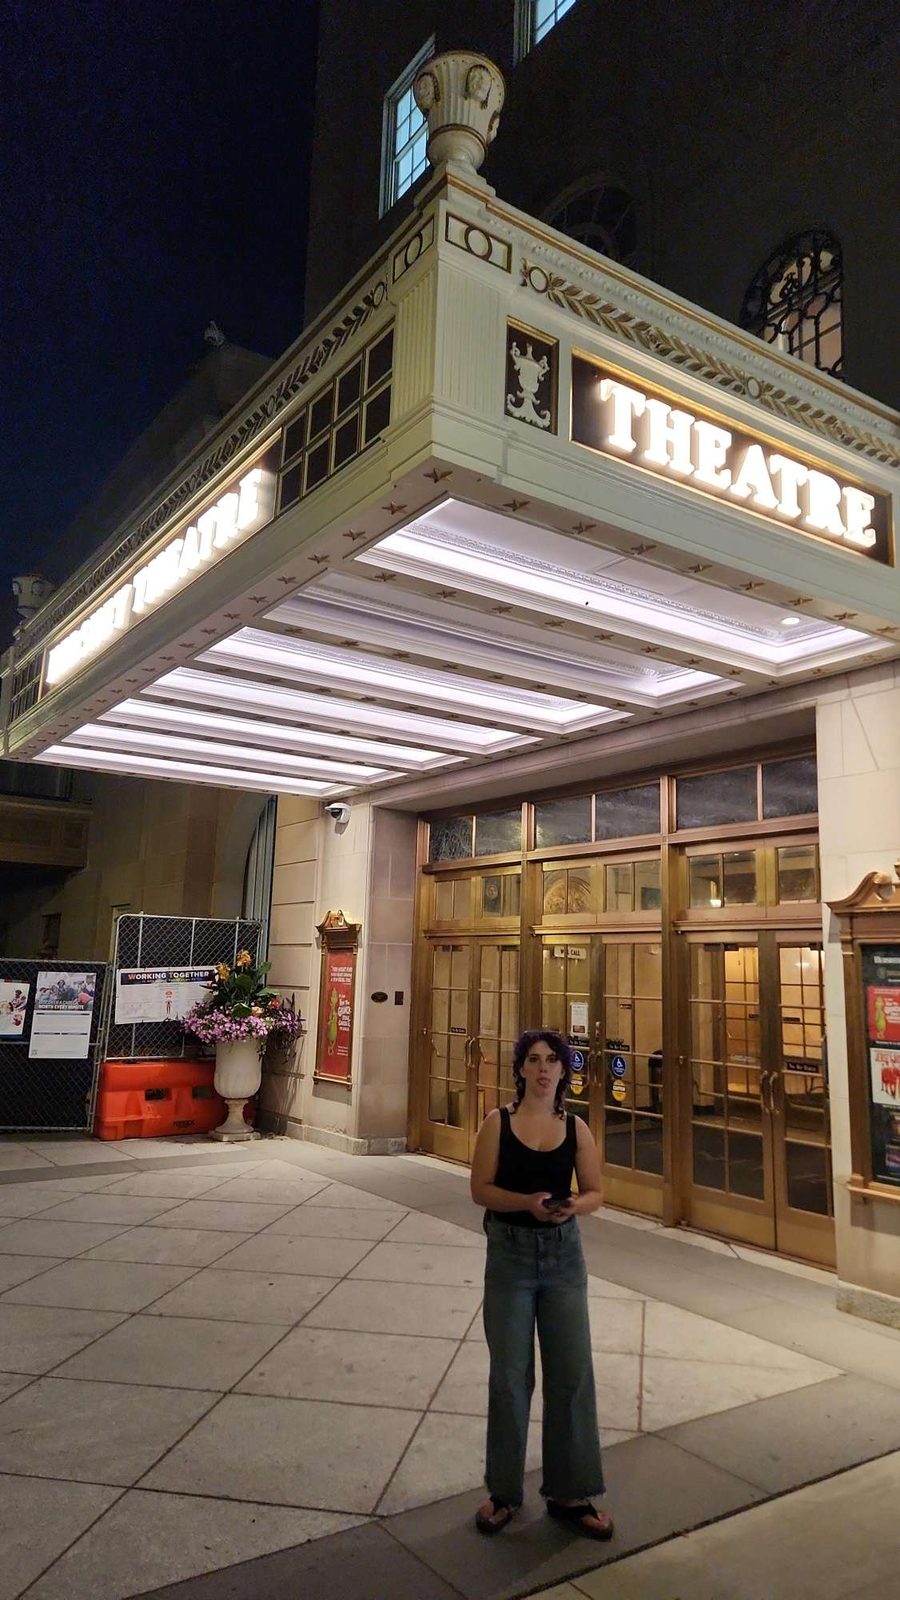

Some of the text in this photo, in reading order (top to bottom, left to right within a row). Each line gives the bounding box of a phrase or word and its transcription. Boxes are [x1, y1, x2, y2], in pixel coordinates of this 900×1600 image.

[600, 379, 876, 546] THEATRE
[570, 949, 580, 957] CALL
[128, 971, 209, 980] WORKING TOGETHER
